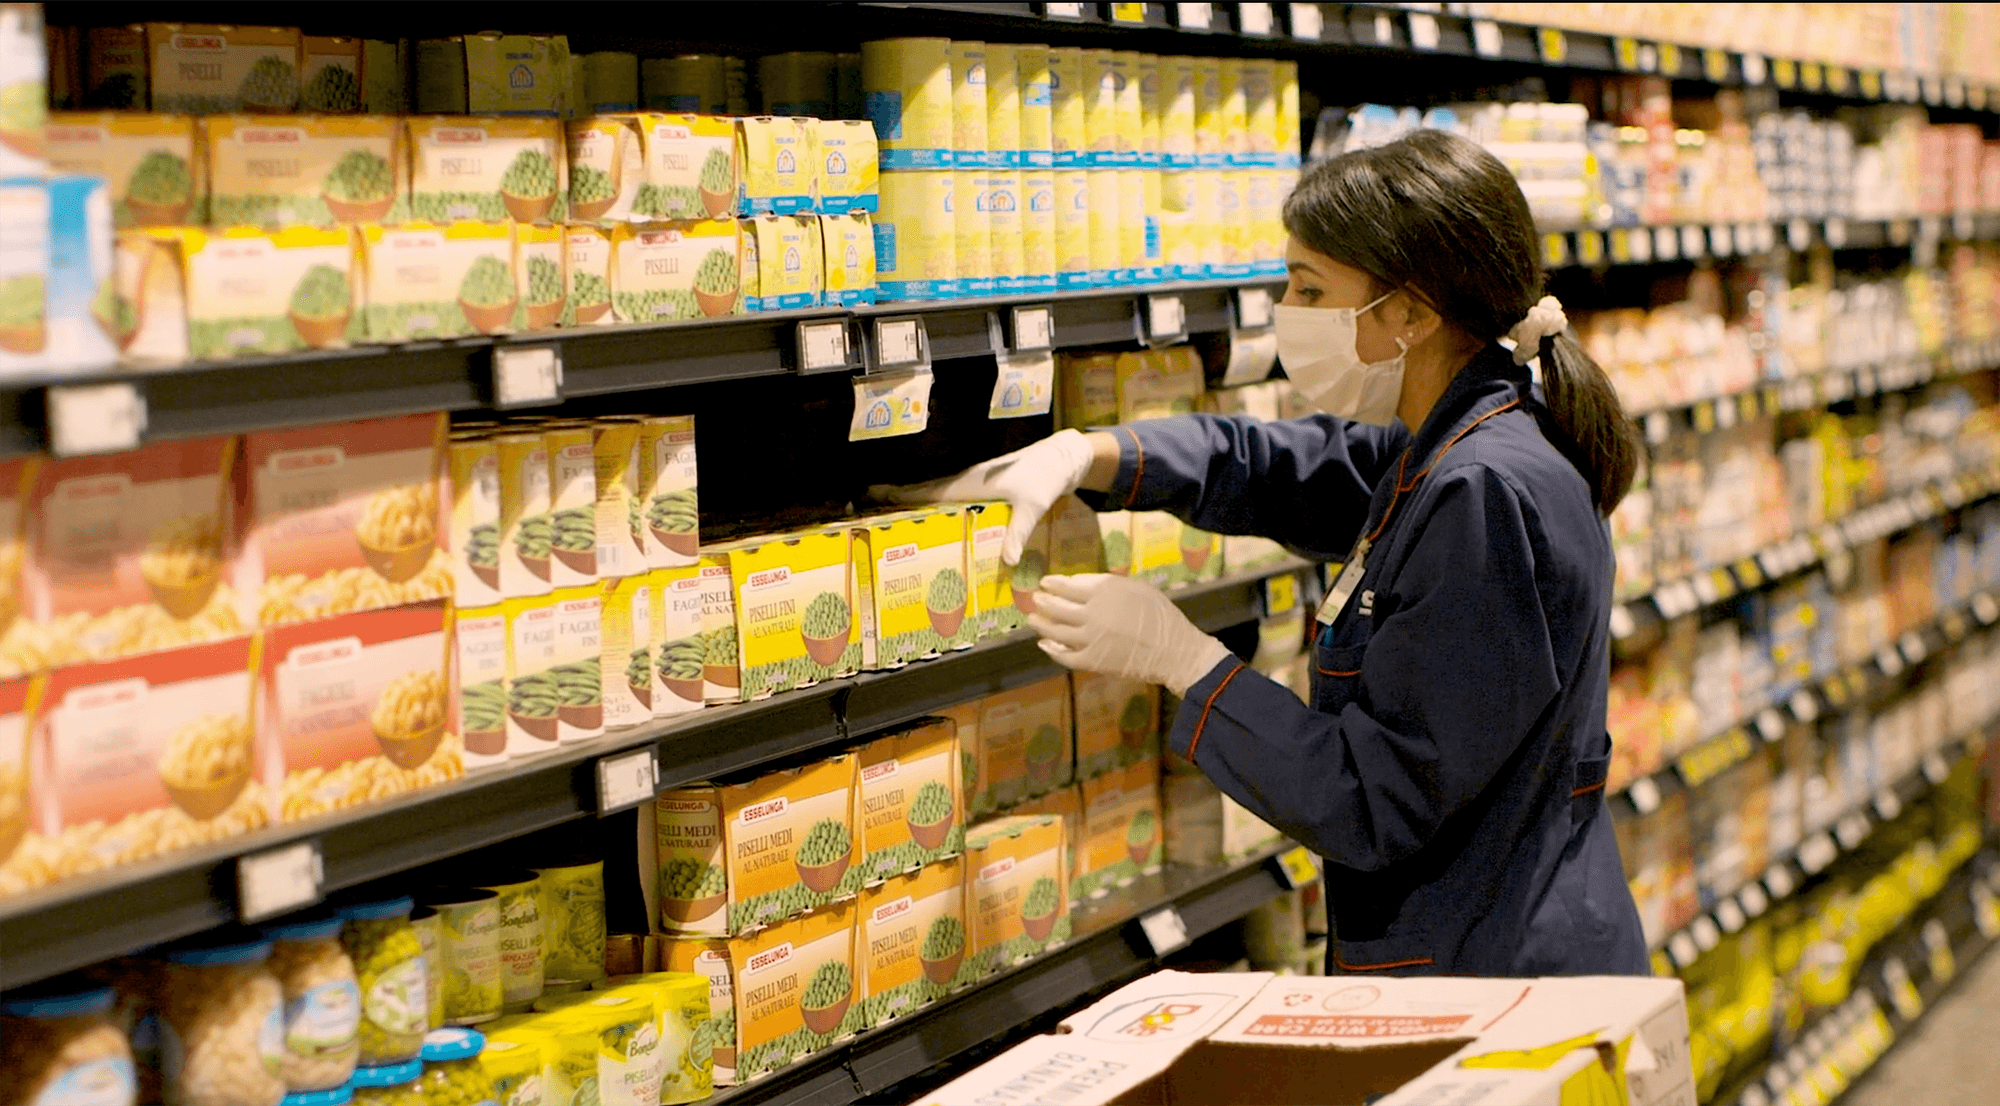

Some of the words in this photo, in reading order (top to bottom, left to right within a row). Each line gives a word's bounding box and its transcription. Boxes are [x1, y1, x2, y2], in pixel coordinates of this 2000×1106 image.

[644, 257, 679, 275] PISELLI
[886, 546, 916, 562] ESSELUNGA
[751, 570, 788, 587] ESSELUNGA
[884, 577, 908, 596] PISELLI
[908, 573, 923, 592] FINI
[749, 602, 778, 623] PISELLI
[780, 598, 797, 617] FINI
[763, 619, 797, 638] NATURALE
[863, 762, 896, 781] ESSELUNGA
[886, 788, 906, 807] MEDI
[744, 801, 784, 822] ESSELUNGA
[684, 825, 716, 837] MEDI
[738, 834, 769, 860] PISELLI
[770, 827, 793, 848] MEDI
[743, 861, 755, 874] AL
[755, 849, 789, 872] NATURALE
[877, 900, 909, 920] ESSELUNGA
[872, 932, 898, 957] PISELLI
[899, 926, 917, 945] MEDI
[751, 946, 788, 971] ESSELUNGA
[746, 982, 775, 1009] PISELLI
[776, 973, 798, 995] MEDI
[751, 1007, 760, 1021] AL
[760, 994, 795, 1019] NATURALE
[1250, 1024, 1305, 1035] CARE
[1310, 1024, 1368, 1036] WITH
[1374, 1022, 1461, 1034] HANDLE
